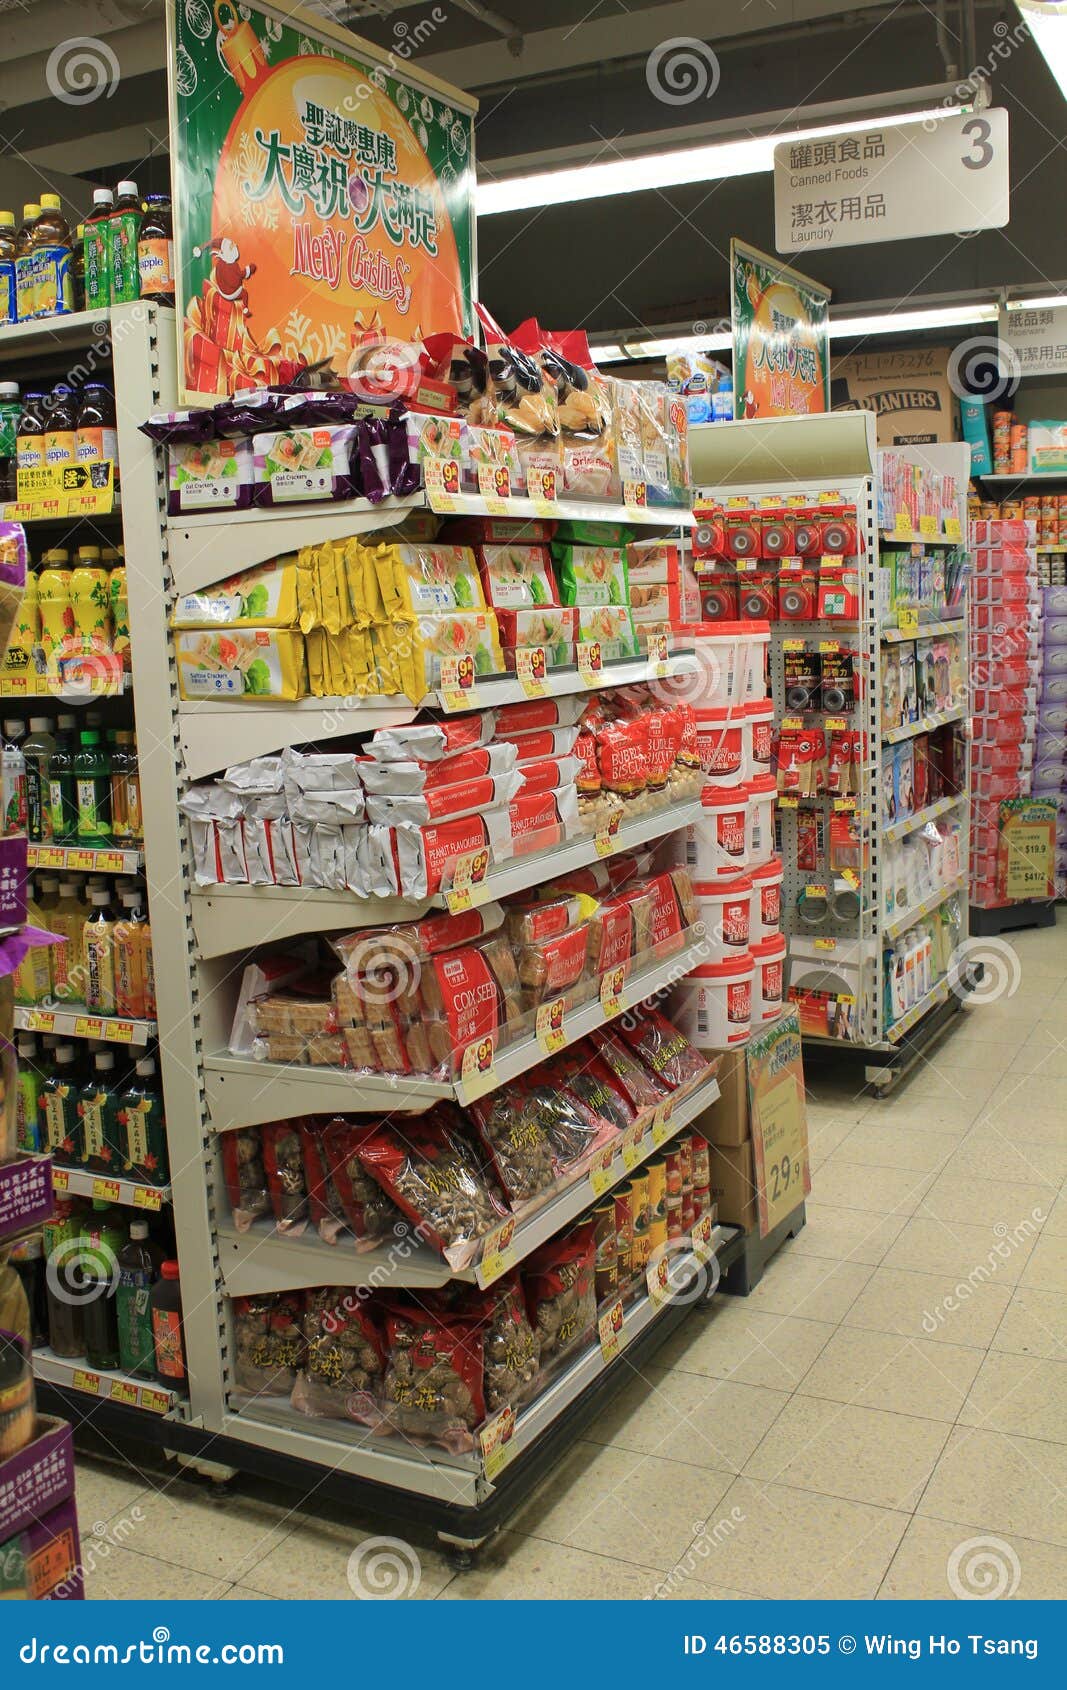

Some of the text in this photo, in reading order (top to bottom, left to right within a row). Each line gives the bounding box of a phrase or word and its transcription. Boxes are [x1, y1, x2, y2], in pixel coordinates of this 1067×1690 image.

[789, 134, 885, 170] 罐頭食品
[961, 118, 994, 170] 3
[790, 166, 869, 188] Canned Foods
[791, 193, 887, 229] 潔衣用品
[791, 227, 834, 243] Laundry
[290, 224, 411, 314] Merry Christmas
[429, 844, 450, 860] PEANUT
[450, 834, 483, 853] FLAVOURED
